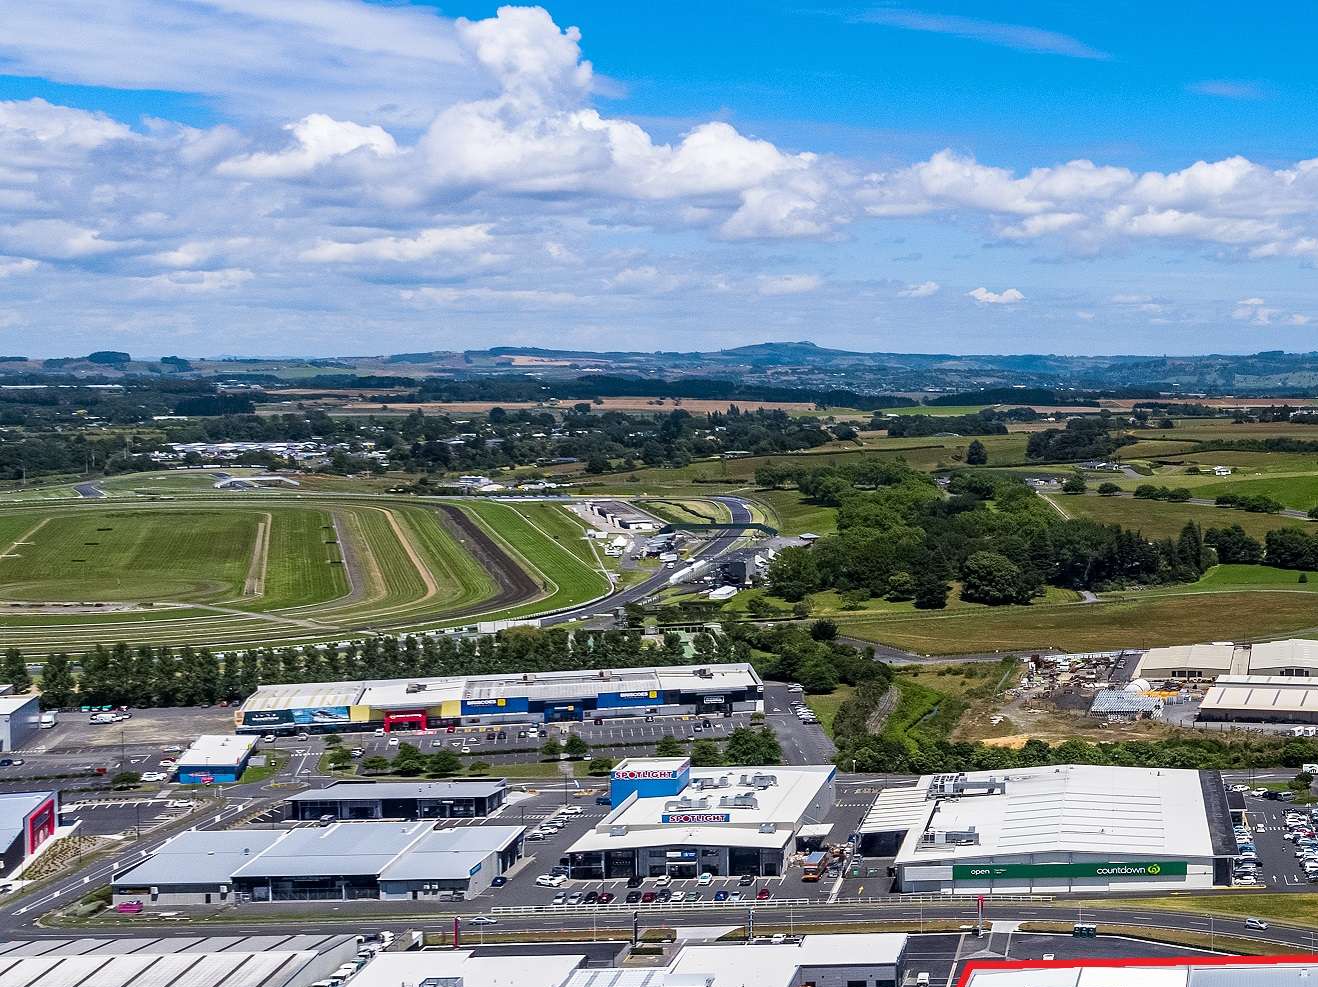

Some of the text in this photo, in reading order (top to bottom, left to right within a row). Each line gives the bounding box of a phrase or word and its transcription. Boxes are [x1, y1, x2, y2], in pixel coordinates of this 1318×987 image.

[615, 770, 673, 779] SPOTLIGHT
[669, 815, 726, 823] SPOTLIGHT
[1096, 865, 1146, 875] countdown
